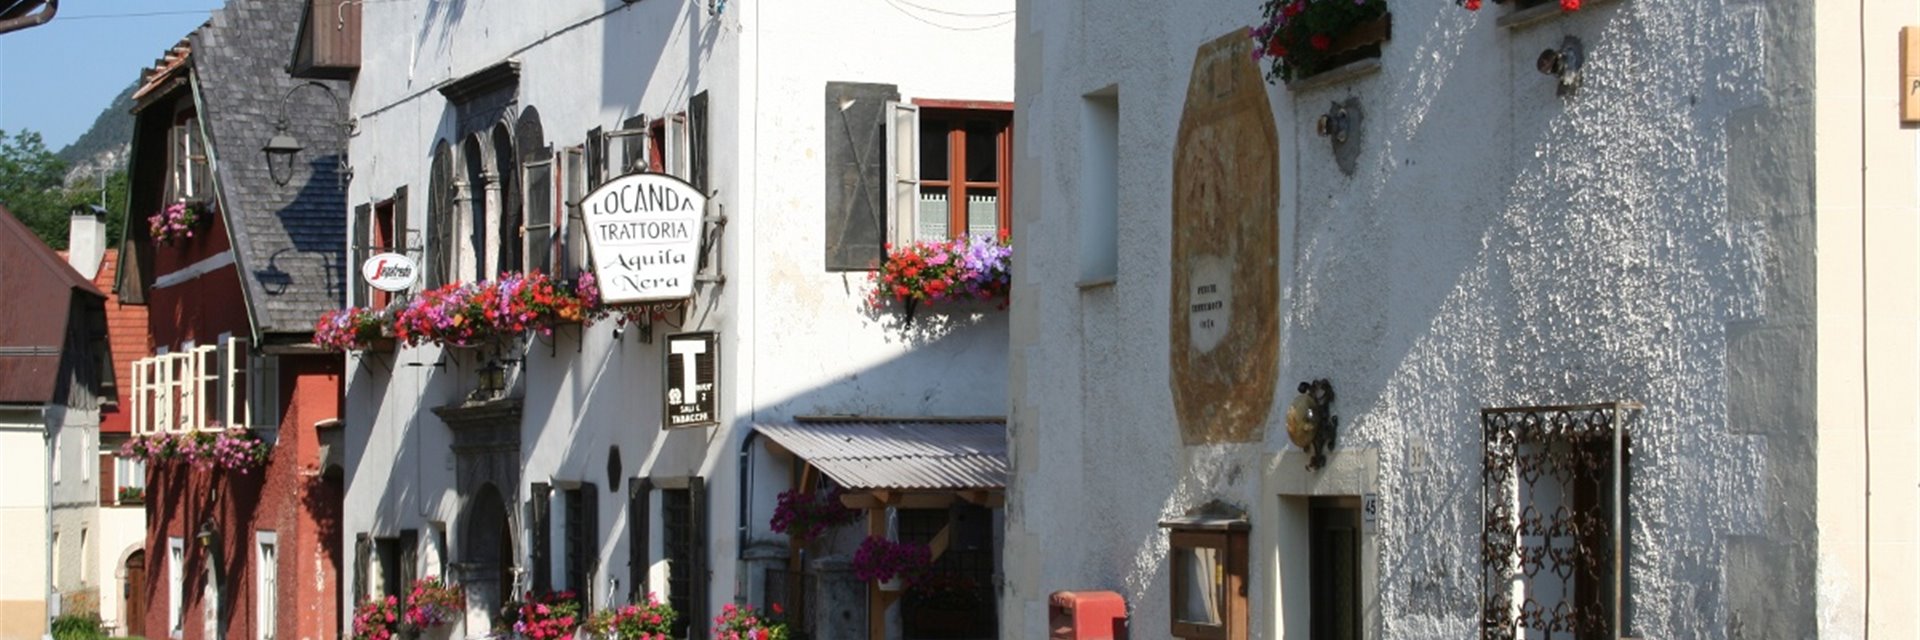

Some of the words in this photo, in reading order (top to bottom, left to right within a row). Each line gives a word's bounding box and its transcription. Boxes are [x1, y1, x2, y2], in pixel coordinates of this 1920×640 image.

[593, 183, 695, 215] LOCANDA
[600, 222, 688, 241] TRATTORIA
[604, 249, 685, 271] Aquila
[612, 274, 679, 293] Nera
[671, 340, 706, 404] T
[672, 412, 708, 424] TABACCHI
[1365, 500, 1376, 515] 45
